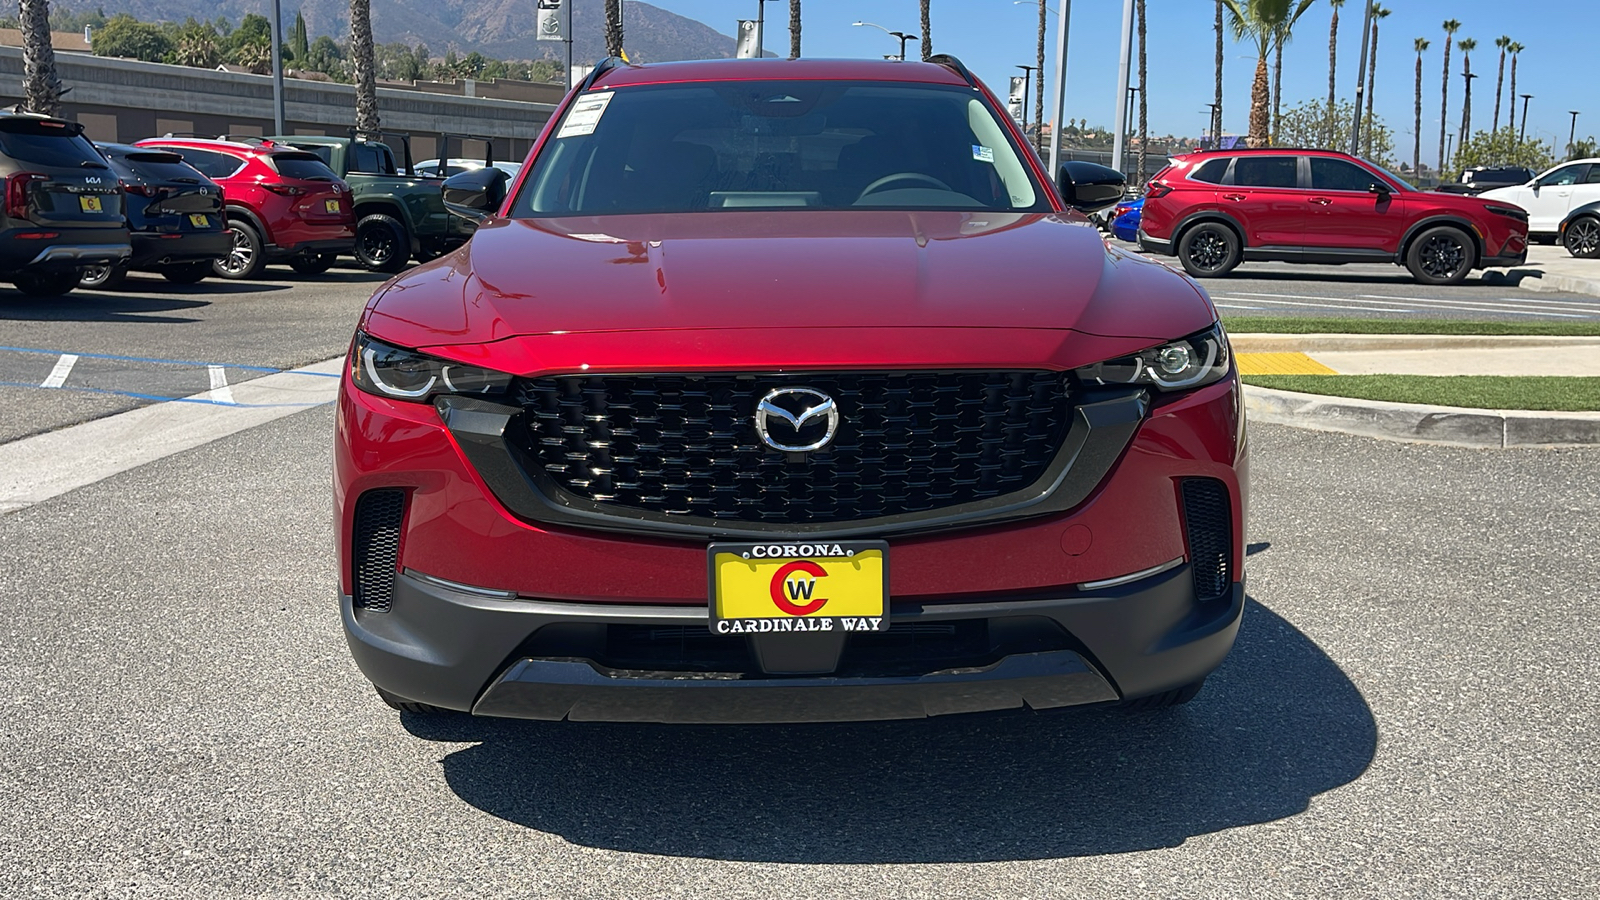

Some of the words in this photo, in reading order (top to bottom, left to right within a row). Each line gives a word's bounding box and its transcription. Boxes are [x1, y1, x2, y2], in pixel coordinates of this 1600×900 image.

[752, 544, 845, 558] CORONA
[770, 560, 829, 616] C
[787, 577, 817, 600] W
[717, 618, 833, 633] CARDINALE
[841, 617, 882, 631] WAY
